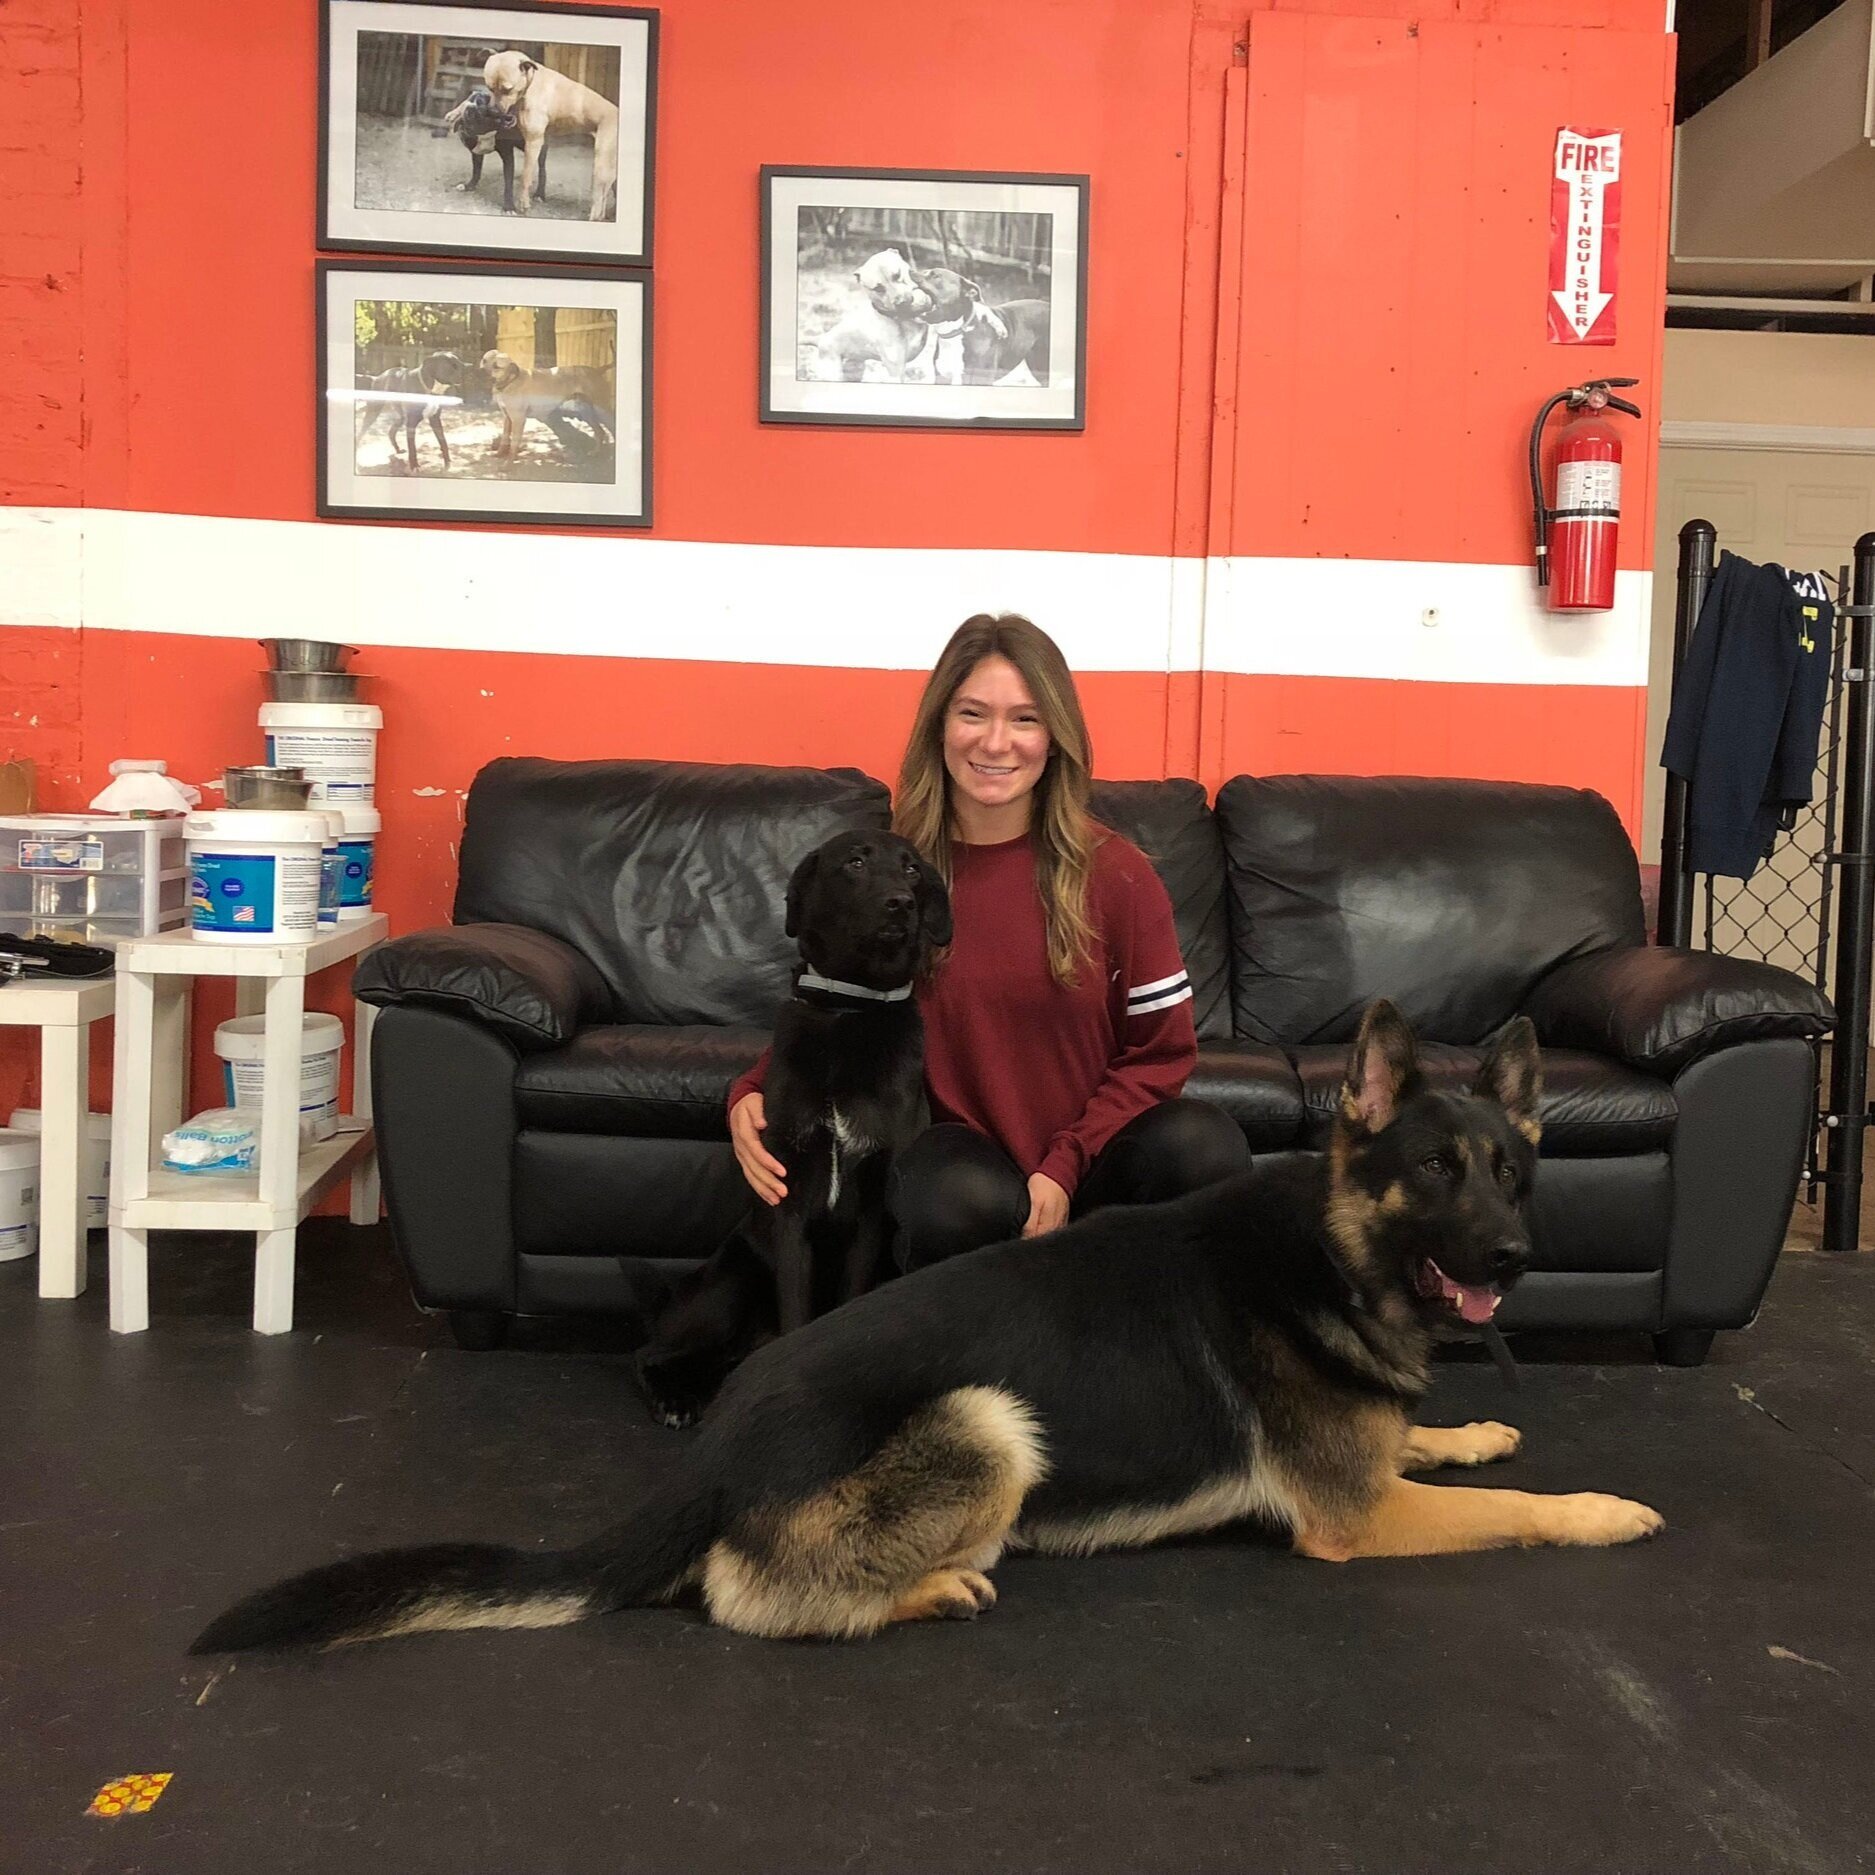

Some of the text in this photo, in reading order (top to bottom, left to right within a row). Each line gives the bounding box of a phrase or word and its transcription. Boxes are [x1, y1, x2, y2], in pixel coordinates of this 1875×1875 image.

[1561, 142, 1614, 172] FIRE
[1575, 174, 1593, 326] EXTINGUISHER
[175, 1130, 208, 1141] Balls
